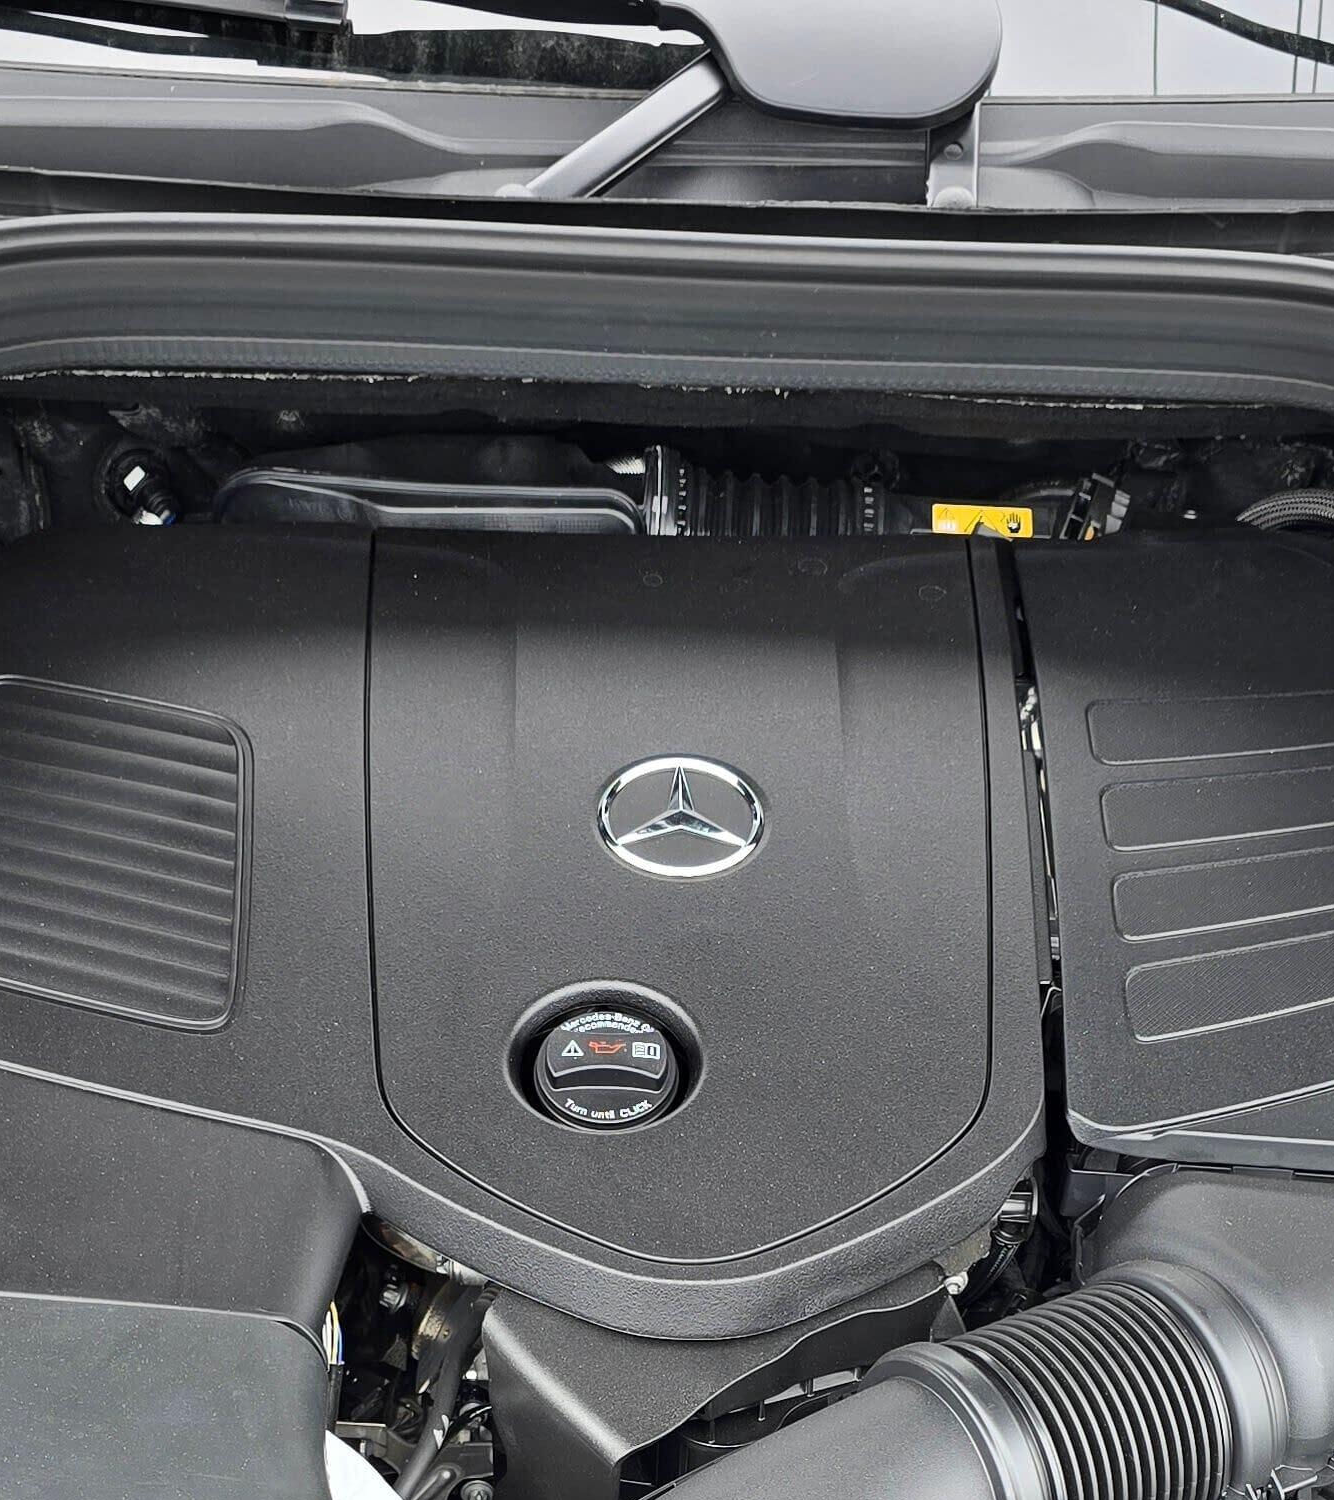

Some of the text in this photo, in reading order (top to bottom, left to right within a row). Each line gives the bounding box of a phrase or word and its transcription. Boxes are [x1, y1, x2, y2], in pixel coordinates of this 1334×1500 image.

[564, 1098, 653, 1120] Turn until CLICK
